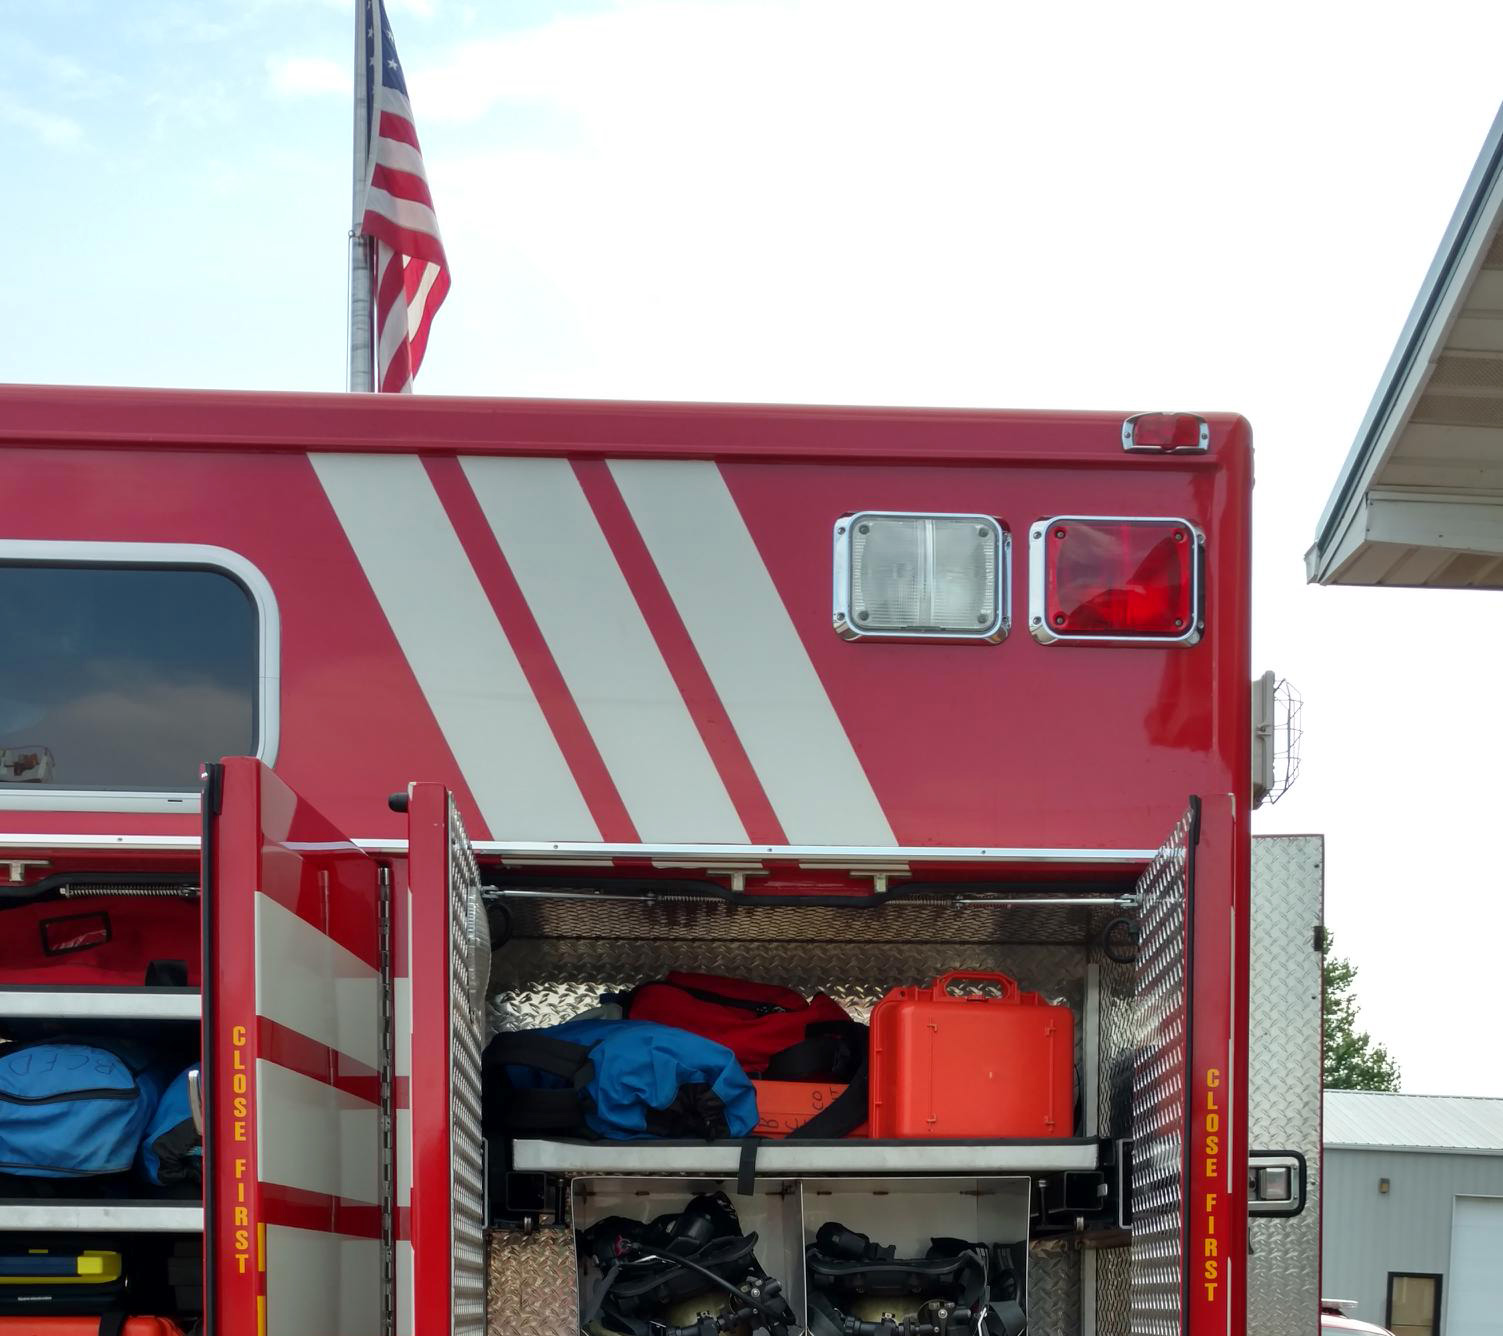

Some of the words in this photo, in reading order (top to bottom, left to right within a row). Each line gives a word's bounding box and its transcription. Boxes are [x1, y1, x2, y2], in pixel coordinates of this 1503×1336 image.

[233, 1026, 247, 1141] CLOSE
[1205, 1068, 1220, 1177] CLOSE
[235, 1159, 249, 1274] FIRST
[1204, 1194, 1218, 1302] FIRST
